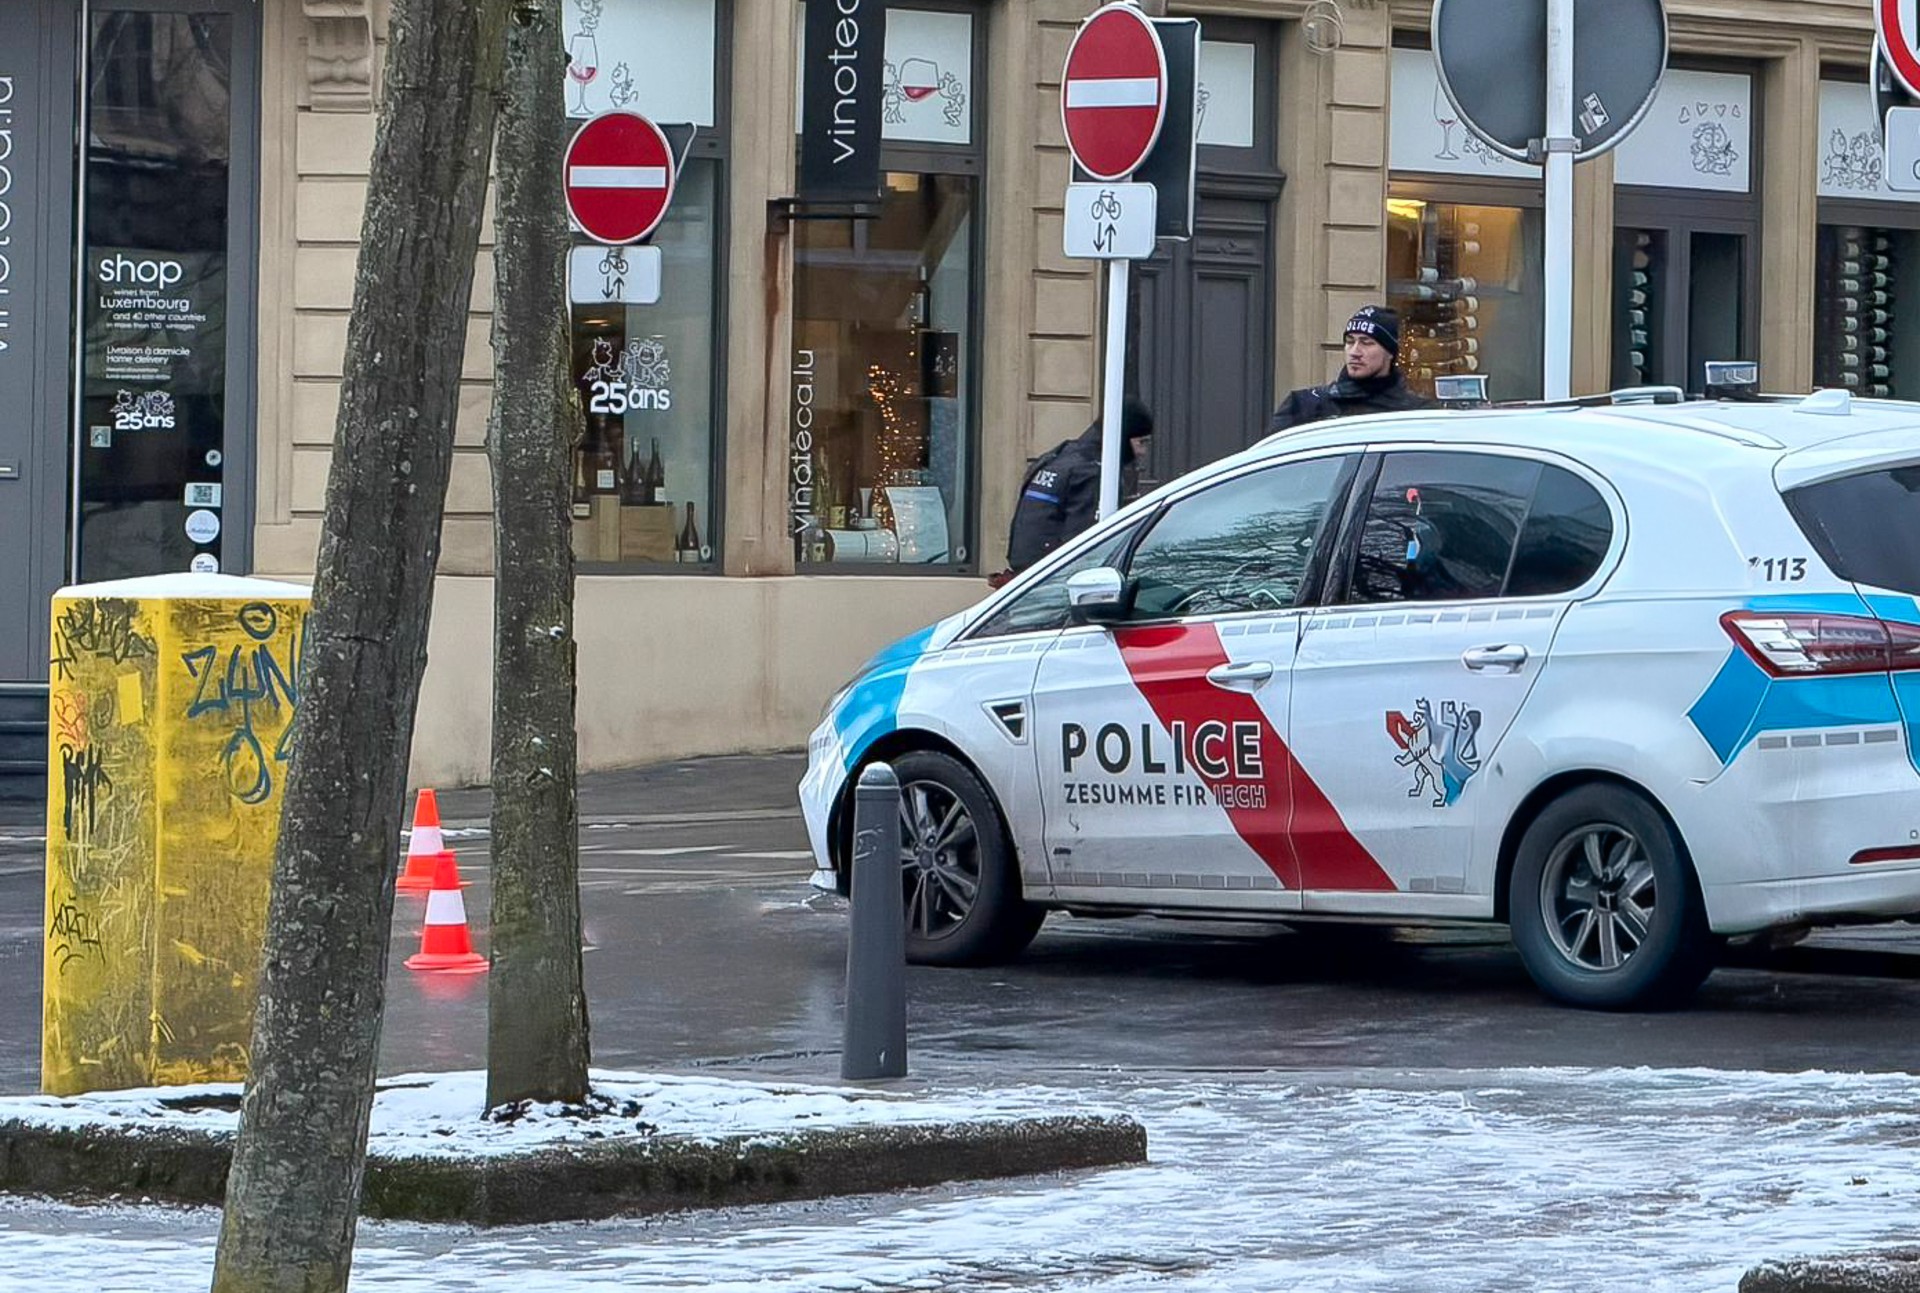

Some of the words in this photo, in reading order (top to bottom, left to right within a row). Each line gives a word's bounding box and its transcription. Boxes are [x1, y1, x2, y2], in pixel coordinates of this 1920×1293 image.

[99, 253, 182, 289] shop
[100, 294, 190, 312] Luxembourg
[790, 350, 814, 533] vinoteca.lu
[1763, 557, 1807, 582] 113
[1061, 720, 1264, 779] POLICE
[1063, 783, 1166, 805] ZESUMME
[1173, 785, 1208, 806] FIR
[1212, 784, 1267, 809] IECH
